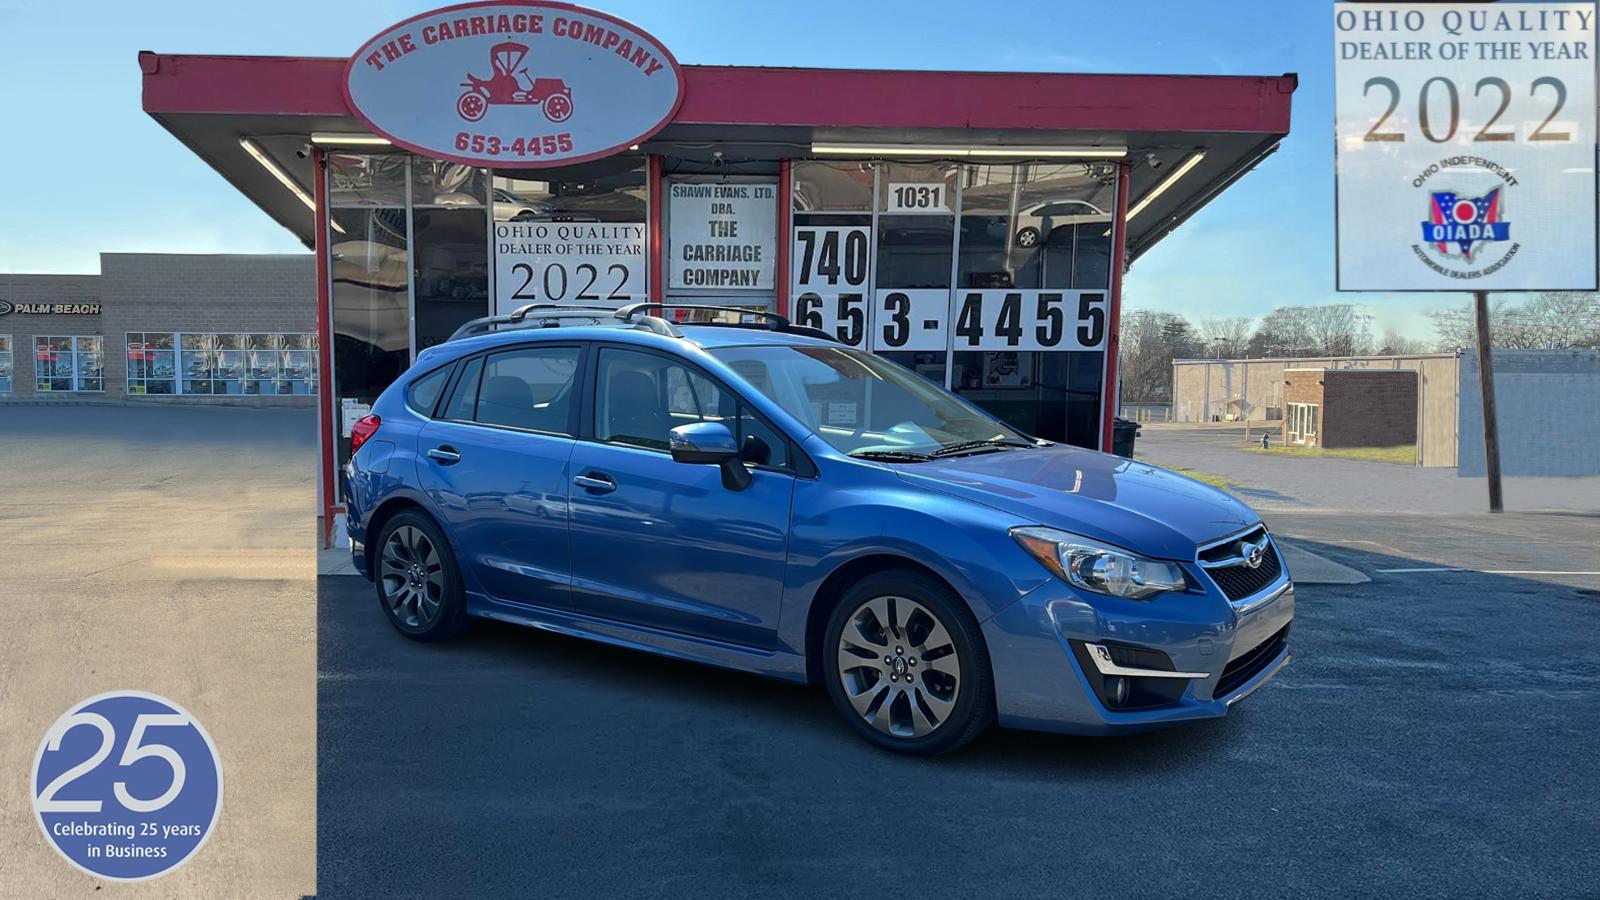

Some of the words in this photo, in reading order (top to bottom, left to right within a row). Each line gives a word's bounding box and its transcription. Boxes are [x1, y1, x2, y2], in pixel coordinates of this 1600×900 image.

[1336, 10, 1425, 32] OHIO
[1442, 10, 1593, 36] QUALITY
[365, 32, 417, 72] THE
[421, 14, 544, 46] CARRIAGE
[552, 17, 664, 77] COMPANY
[1340, 42, 1433, 60] DEALER
[1439, 41, 1469, 60] OF
[1474, 42, 1522, 60] THE
[1528, 42, 1589, 60] YEAR
[1363, 76, 1571, 143] 2022
[455, 131, 573, 157] 653-4455
[1412, 164, 1439, 188] OHIO
[1440, 155, 1519, 188] INDEPENDENT
[672, 186, 713, 200] SHAWN
[754, 187, 775, 200] LTD.
[894, 186, 941, 209] 1031
[711, 203, 736, 216] DBA.
[497, 225, 552, 240] OHIO
[557, 225, 645, 241] QUALITY
[708, 220, 738, 238] THE
[1432, 224, 1495, 241] OIADA
[499, 243, 552, 255] DEALER
[555, 243, 574, 255] OF
[576, 243, 604, 255] THE
[606, 243, 642, 255] YEAR
[683, 244, 763, 263] CARRIAGE
[797, 230, 868, 287] 740
[1411, 243, 1449, 276] AUTOMOBILE
[1449, 269, 1482, 280] DEALERS
[1483, 242, 1521, 276] ASSOCIATION
[511, 262, 632, 301] 2022
[683, 268, 761, 287] COMPANY
[15, 303, 51, 314] PALM
[54, 304, 100, 314] BEACH
